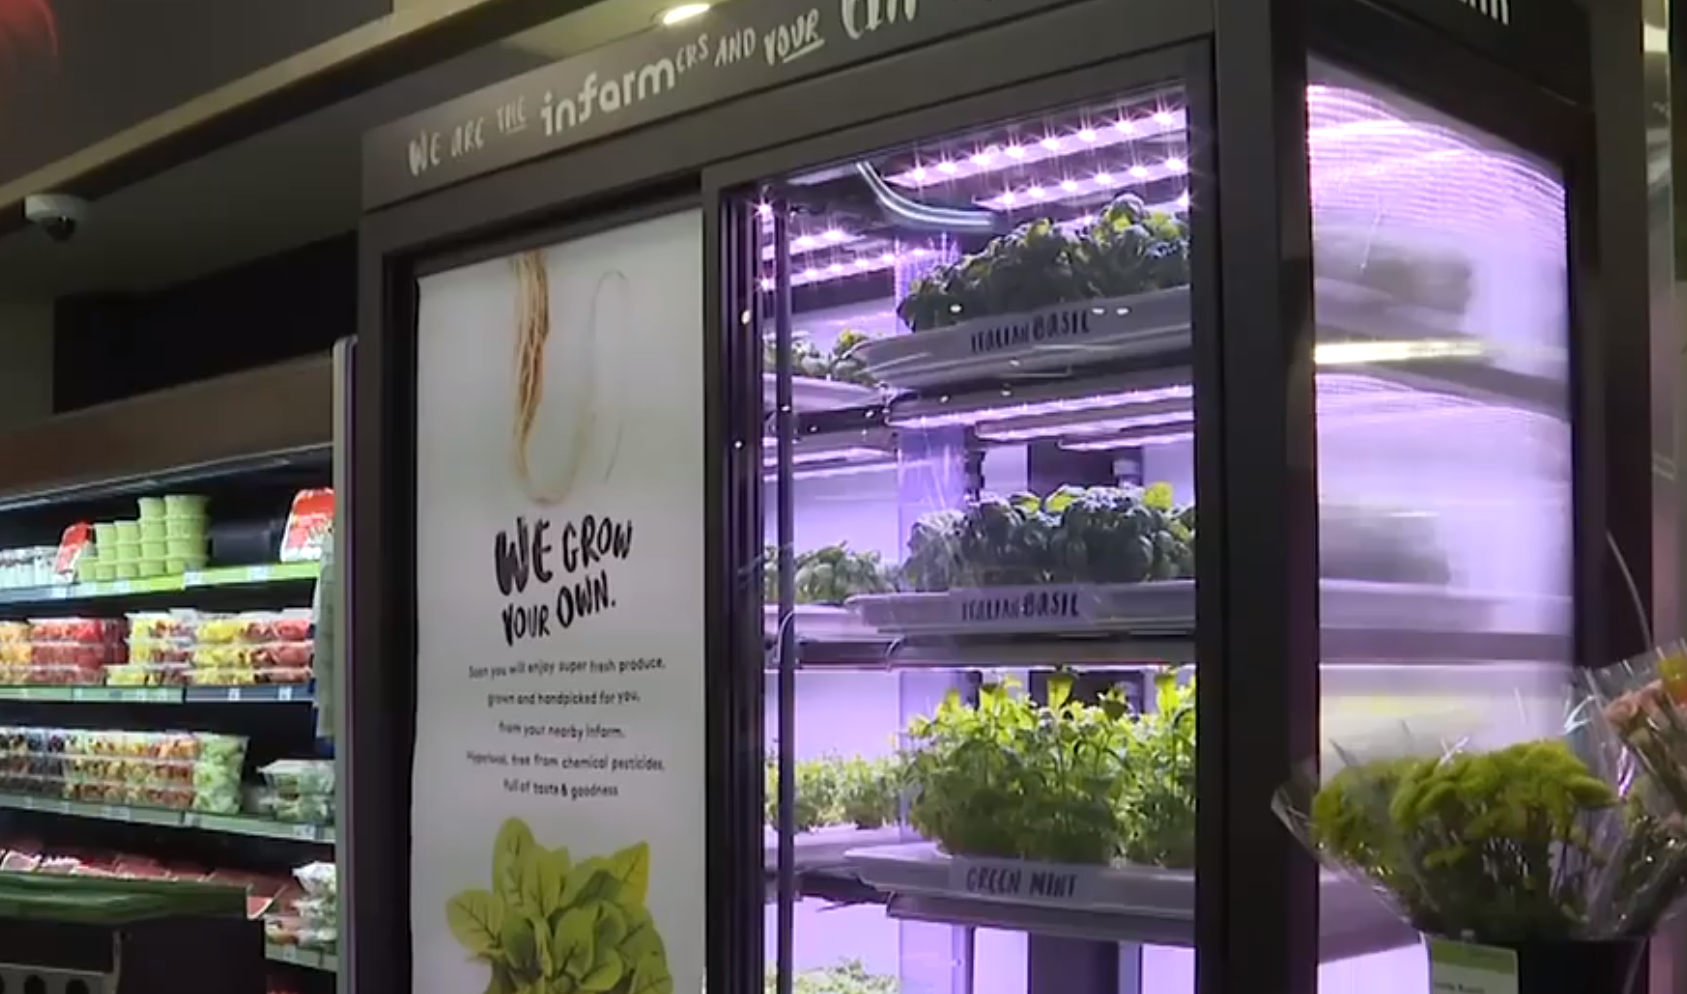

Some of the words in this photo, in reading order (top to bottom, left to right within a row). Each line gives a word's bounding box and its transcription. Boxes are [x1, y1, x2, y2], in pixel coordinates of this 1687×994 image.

[409, 129, 441, 177] WE
[451, 116, 485, 158] ARE
[497, 93, 528, 136] THE
[714, 27, 757, 68] AND
[763, 13, 825, 66] YOUR
[1031, 309, 1091, 342] BASIL
[494, 516, 553, 597] WE
[562, 514, 632, 573] GROW
[502, 603, 551, 647] YOUR
[556, 570, 617, 629] OWN.
[1022, 591, 1080, 617] BASIL
[490, 665, 507, 681] you
[509, 660, 526, 675] will
[528, 658, 555, 678] enjoy
[559, 659, 588, 675] super
[590, 658, 617, 674] fresh
[517, 693, 536, 705] and
[538, 691, 598, 709] handpicked
[600, 690, 616, 705] for
[498, 720, 522, 735] from
[523, 725, 546, 739] your
[548, 724, 583, 743] nearby
[511, 754, 531, 767] free
[534, 752, 559, 767] from
[561, 754, 609, 770] chemical
[520, 780, 531, 794] of
[532, 782, 559, 795] taste
[561, 782, 569, 797] &
[571, 784, 619, 801] goodness
[966, 867, 1022, 895] GREEN
[1029, 871, 1079, 898] MINT
